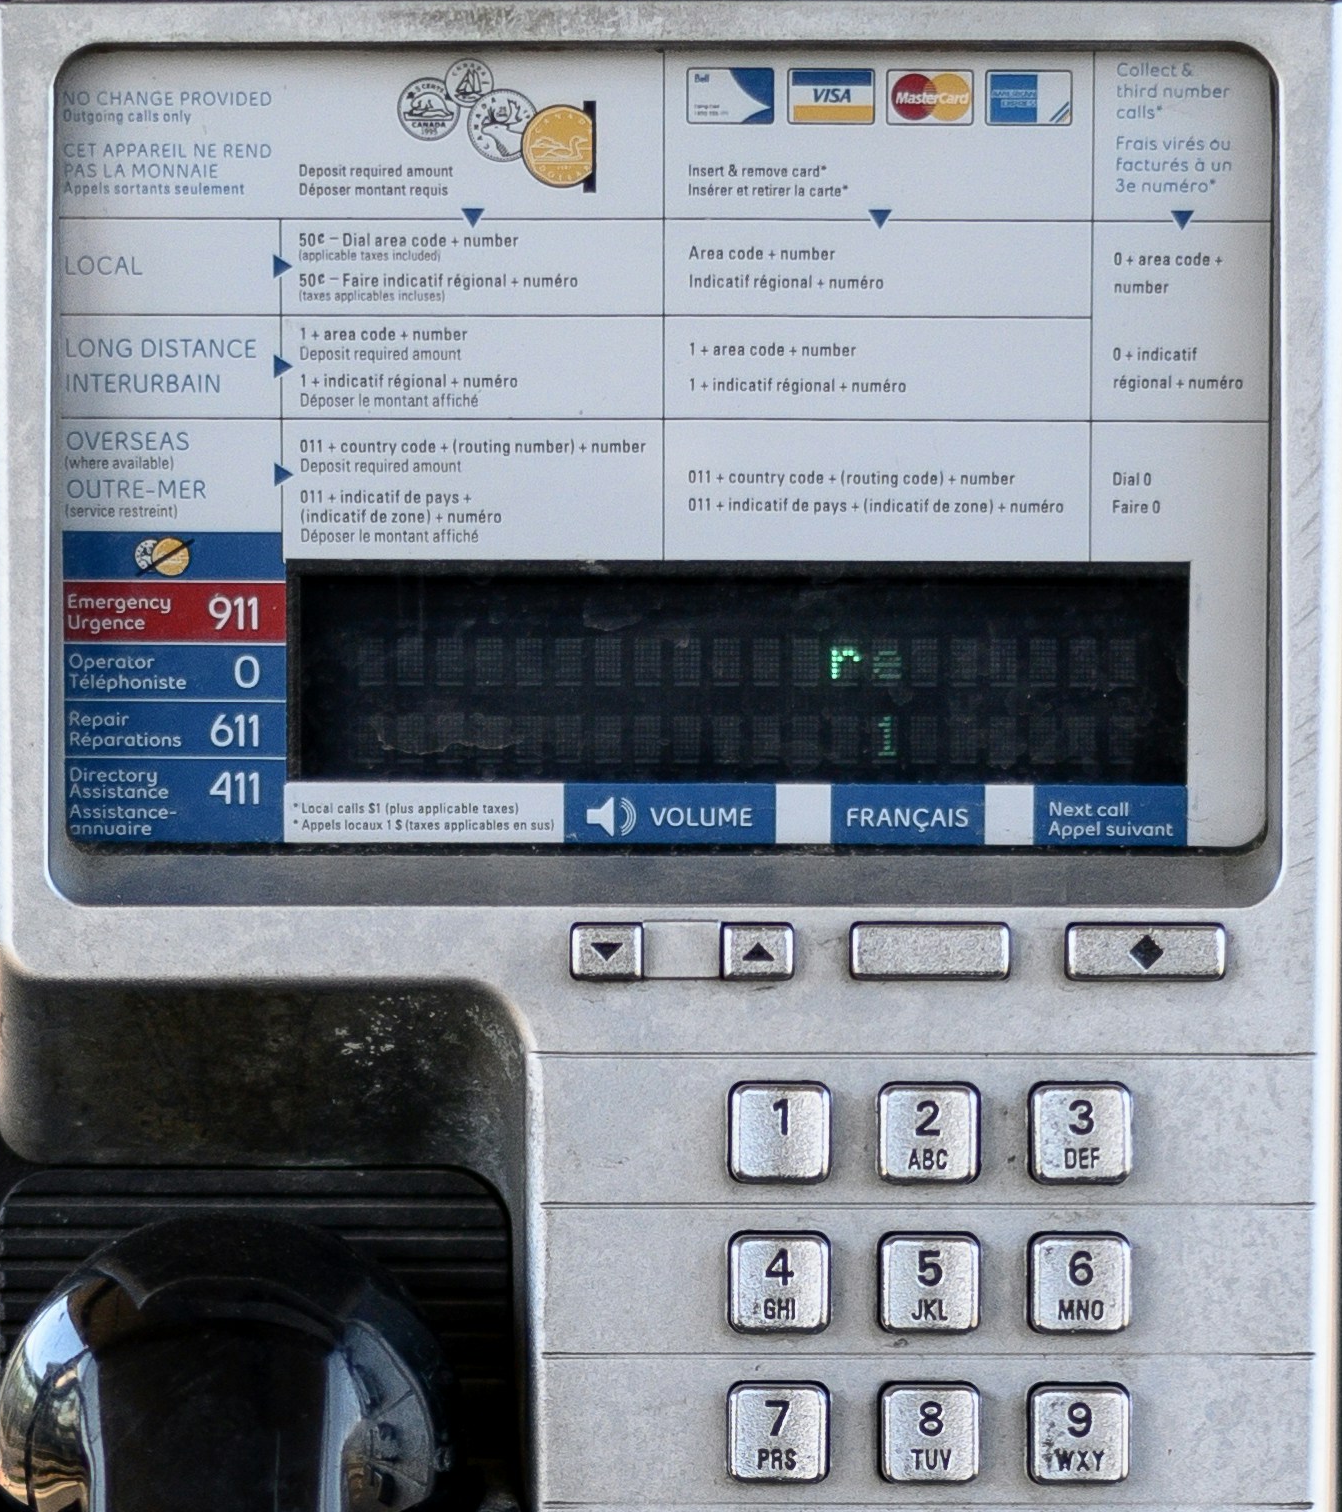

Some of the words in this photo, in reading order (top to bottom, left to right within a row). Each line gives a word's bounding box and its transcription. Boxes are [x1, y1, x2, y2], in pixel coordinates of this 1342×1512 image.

[1115, 62, 1176, 79] Collect
[63, 91, 91, 107] NO
[97, 91, 173, 107] CHANGE
[180, 91, 272, 107] PROVIDED
[813, 87, 851, 103] VISA
[895, 90, 970, 106] MasterCard
[1117, 83, 1158, 99] third
[1163, 83, 1233, 99] number
[62, 109, 124, 126] Outgoing
[127, 109, 158, 122] calls
[162, 110, 192, 126] only
[63, 143, 98, 159] CET
[102, 142, 186, 158] APPAREIL
[194, 143, 215, 158] NE
[223, 143, 271, 158] REND
[1116, 135, 1158, 151] Frais
[1162, 135, 1205, 152] virés
[63, 163, 97, 179] PAS
[103, 163, 126, 179] LA
[132, 163, 218, 179] MONNAIE
[298, 163, 347, 179] Deposit
[349, 164, 403, 180] required
[406, 165, 454, 178] amount
[688, 164, 725, 177] Insert
[727, 163, 738, 178] &
[741, 166, 788, 178] remove
[1116, 156, 1189, 173] facturés
[1194, 157, 1206, 172] à
[1210, 160, 1233, 173] un
[63, 181, 110, 199] Appels
[114, 183, 171, 196] sortants
[174, 182, 245, 196] seulement
[298, 182, 352, 198] Déposer
[354, 184, 407, 196] montant
[409, 185, 449, 199] requis
[688, 183, 733, 197] Insérer
[736, 185, 749, 197] et
[751, 184, 791, 197] retirer
[794, 184, 806, 197] la
[1115, 177, 1136, 193] 3e
[298, 249, 357, 262] (applicable
[360, 251, 389, 261] taxes
[392, 249, 441, 262] included)
[688, 245, 724, 260] Area
[728, 245, 764, 261] code
[780, 246, 836, 261] number
[65, 255, 143, 276] LOCAL
[689, 273, 750, 289] Indicatif
[753, 274, 813, 292] régional
[828, 274, 884, 290] numéro
[298, 290, 331, 302] (taxes
[334, 290, 395, 303] applicables
[398, 290, 445, 302] incluses)
[65, 338, 134, 360] LONG
[141, 338, 256, 358] DISTANCE
[299, 345, 351, 363] Deposit
[353, 346, 409, 364] required
[412, 348, 462, 361] amount
[65, 374, 221, 395] INTERURBAIN
[300, 392, 355, 410] Déposer
[358, 393, 370, 408] le
[373, 394, 429, 408] montant
[432, 392, 479, 408] affiché
[65, 431, 190, 452] OVERSEAS
[64, 455, 109, 472] (where
[112, 455, 175, 472] available)
[1112, 471, 1140, 487] Dial
[1143, 471, 1152, 487] 0
[65, 479, 207, 500] OUTRE-MER
[64, 503, 114, 520] (service
[118, 503, 179, 520] restreint)
[1112, 499, 1149, 514] Faire
[1151, 499, 1161, 514] 0
[66, 593, 172, 614] Emergency
[208, 593, 258, 630] 911
[67, 615, 146, 634] Urgence
[69, 654, 156, 675] Operator
[234, 654, 260, 689] 0
[69, 672, 188, 693] Téléphoniste
[68, 711, 131, 731] Repair
[210, 713, 259, 747] 611
[69, 730, 184, 750] Réparations
[69, 767, 160, 789] Directory
[209, 771, 260, 805] 411
[69, 782, 171, 801] Assistance
[69, 803, 178, 822] Assistance-
[301, 802, 334, 814] Local
[337, 802, 365, 814] calls
[368, 802, 381, 815] $1
[385, 802, 414, 816] (plus
[417, 802, 479, 816] applicable
[482, 802, 519, 815] taxes)
[649, 806, 753, 827] VOLUME
[1049, 801, 1093, 817] Next
[1096, 801, 1129, 817] call
[69, 821, 154, 837] annuaire
[846, 807, 969, 833] FRANÇAIS
[1048, 820, 1101, 839] Appel
[1105, 821, 1174, 837] suivant
[772, 1098, 789, 1136] 1
[915, 1099, 941, 1137] 2
[1069, 1098, 1094, 1136] 3
[908, 1147, 948, 1171] ABC
[1064, 1146, 1100, 1170] DEF
[765, 1247, 795, 1286] 4
[918, 1249, 943, 1287] 5
[1069, 1250, 1094, 1287] 6
[763, 1297, 796, 1320] GHI
[911, 1298, 948, 1321] JKL
[1058, 1299, 1104, 1321] MNO
[765, 1399, 790, 1437] 7
[919, 1400, 944, 1437] 8
[1067, 1401, 1092, 1439] 9
[757, 1447, 797, 1471] PRS
[910, 1448, 952, 1471] TUV
[1053, 1448, 1105, 1472] WXY
